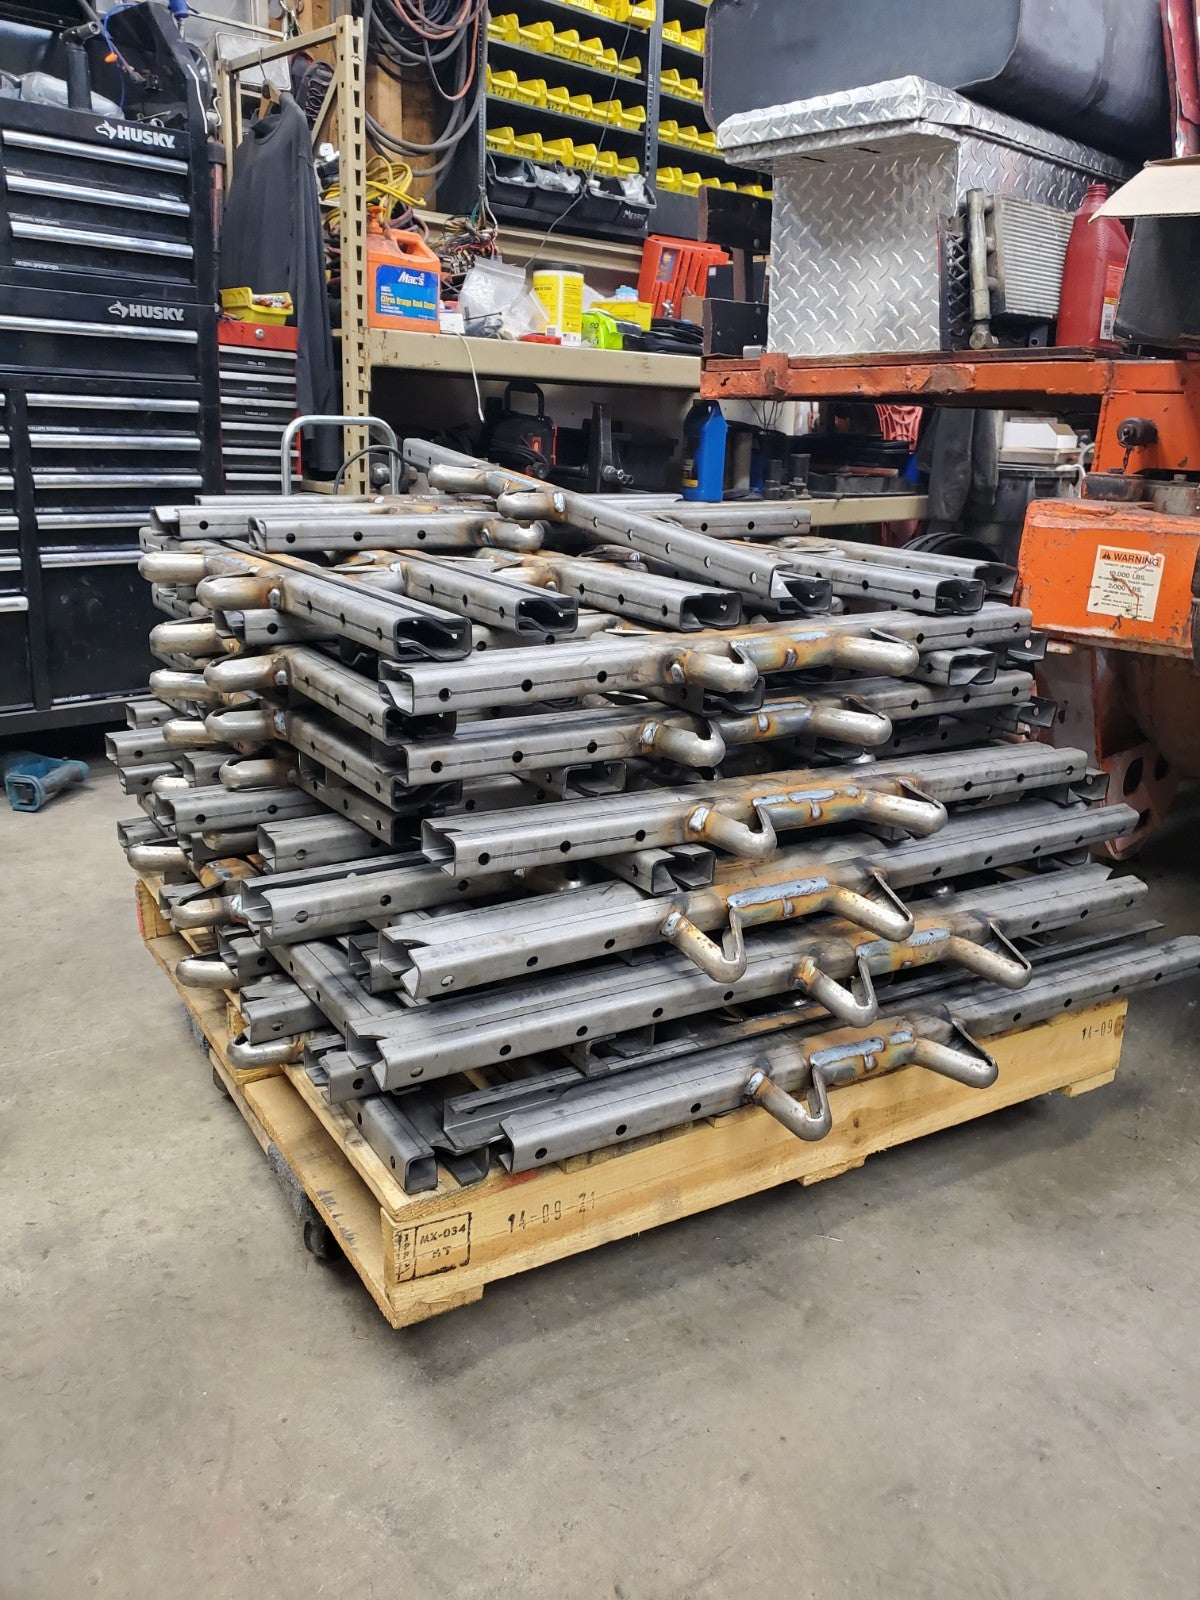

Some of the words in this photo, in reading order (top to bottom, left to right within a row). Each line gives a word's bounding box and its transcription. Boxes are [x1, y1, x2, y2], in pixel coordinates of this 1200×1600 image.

[117, 125, 175, 149] HUSKY
[398, 271, 425, 286] Mac's
[129, 304, 184, 321] HUSKY
[1114, 552, 1159, 567] WARNING
